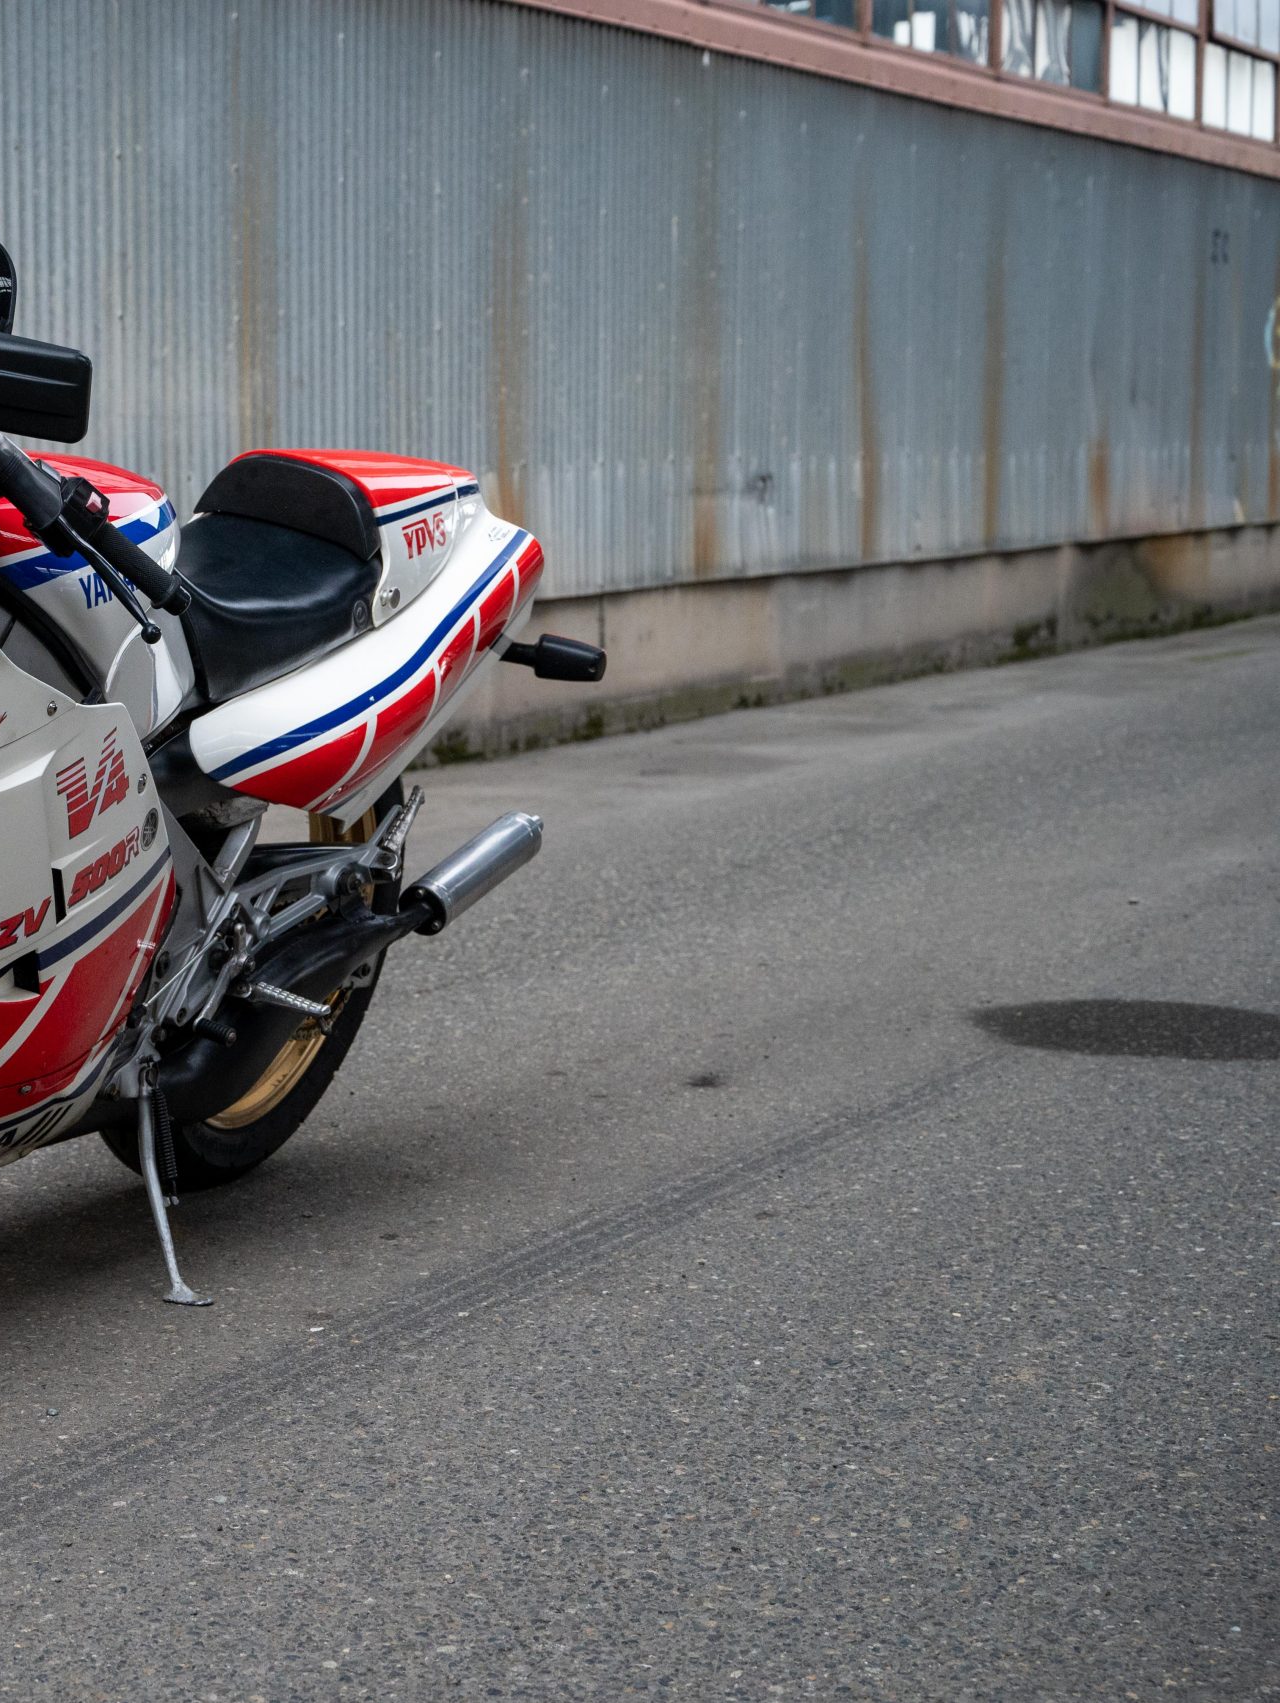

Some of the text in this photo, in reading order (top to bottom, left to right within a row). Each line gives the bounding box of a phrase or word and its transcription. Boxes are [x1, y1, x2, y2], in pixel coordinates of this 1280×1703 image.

[401, 511, 447, 560] YPVS
[56, 726, 130, 840] V4
[67, 826, 140, 909] 500R
